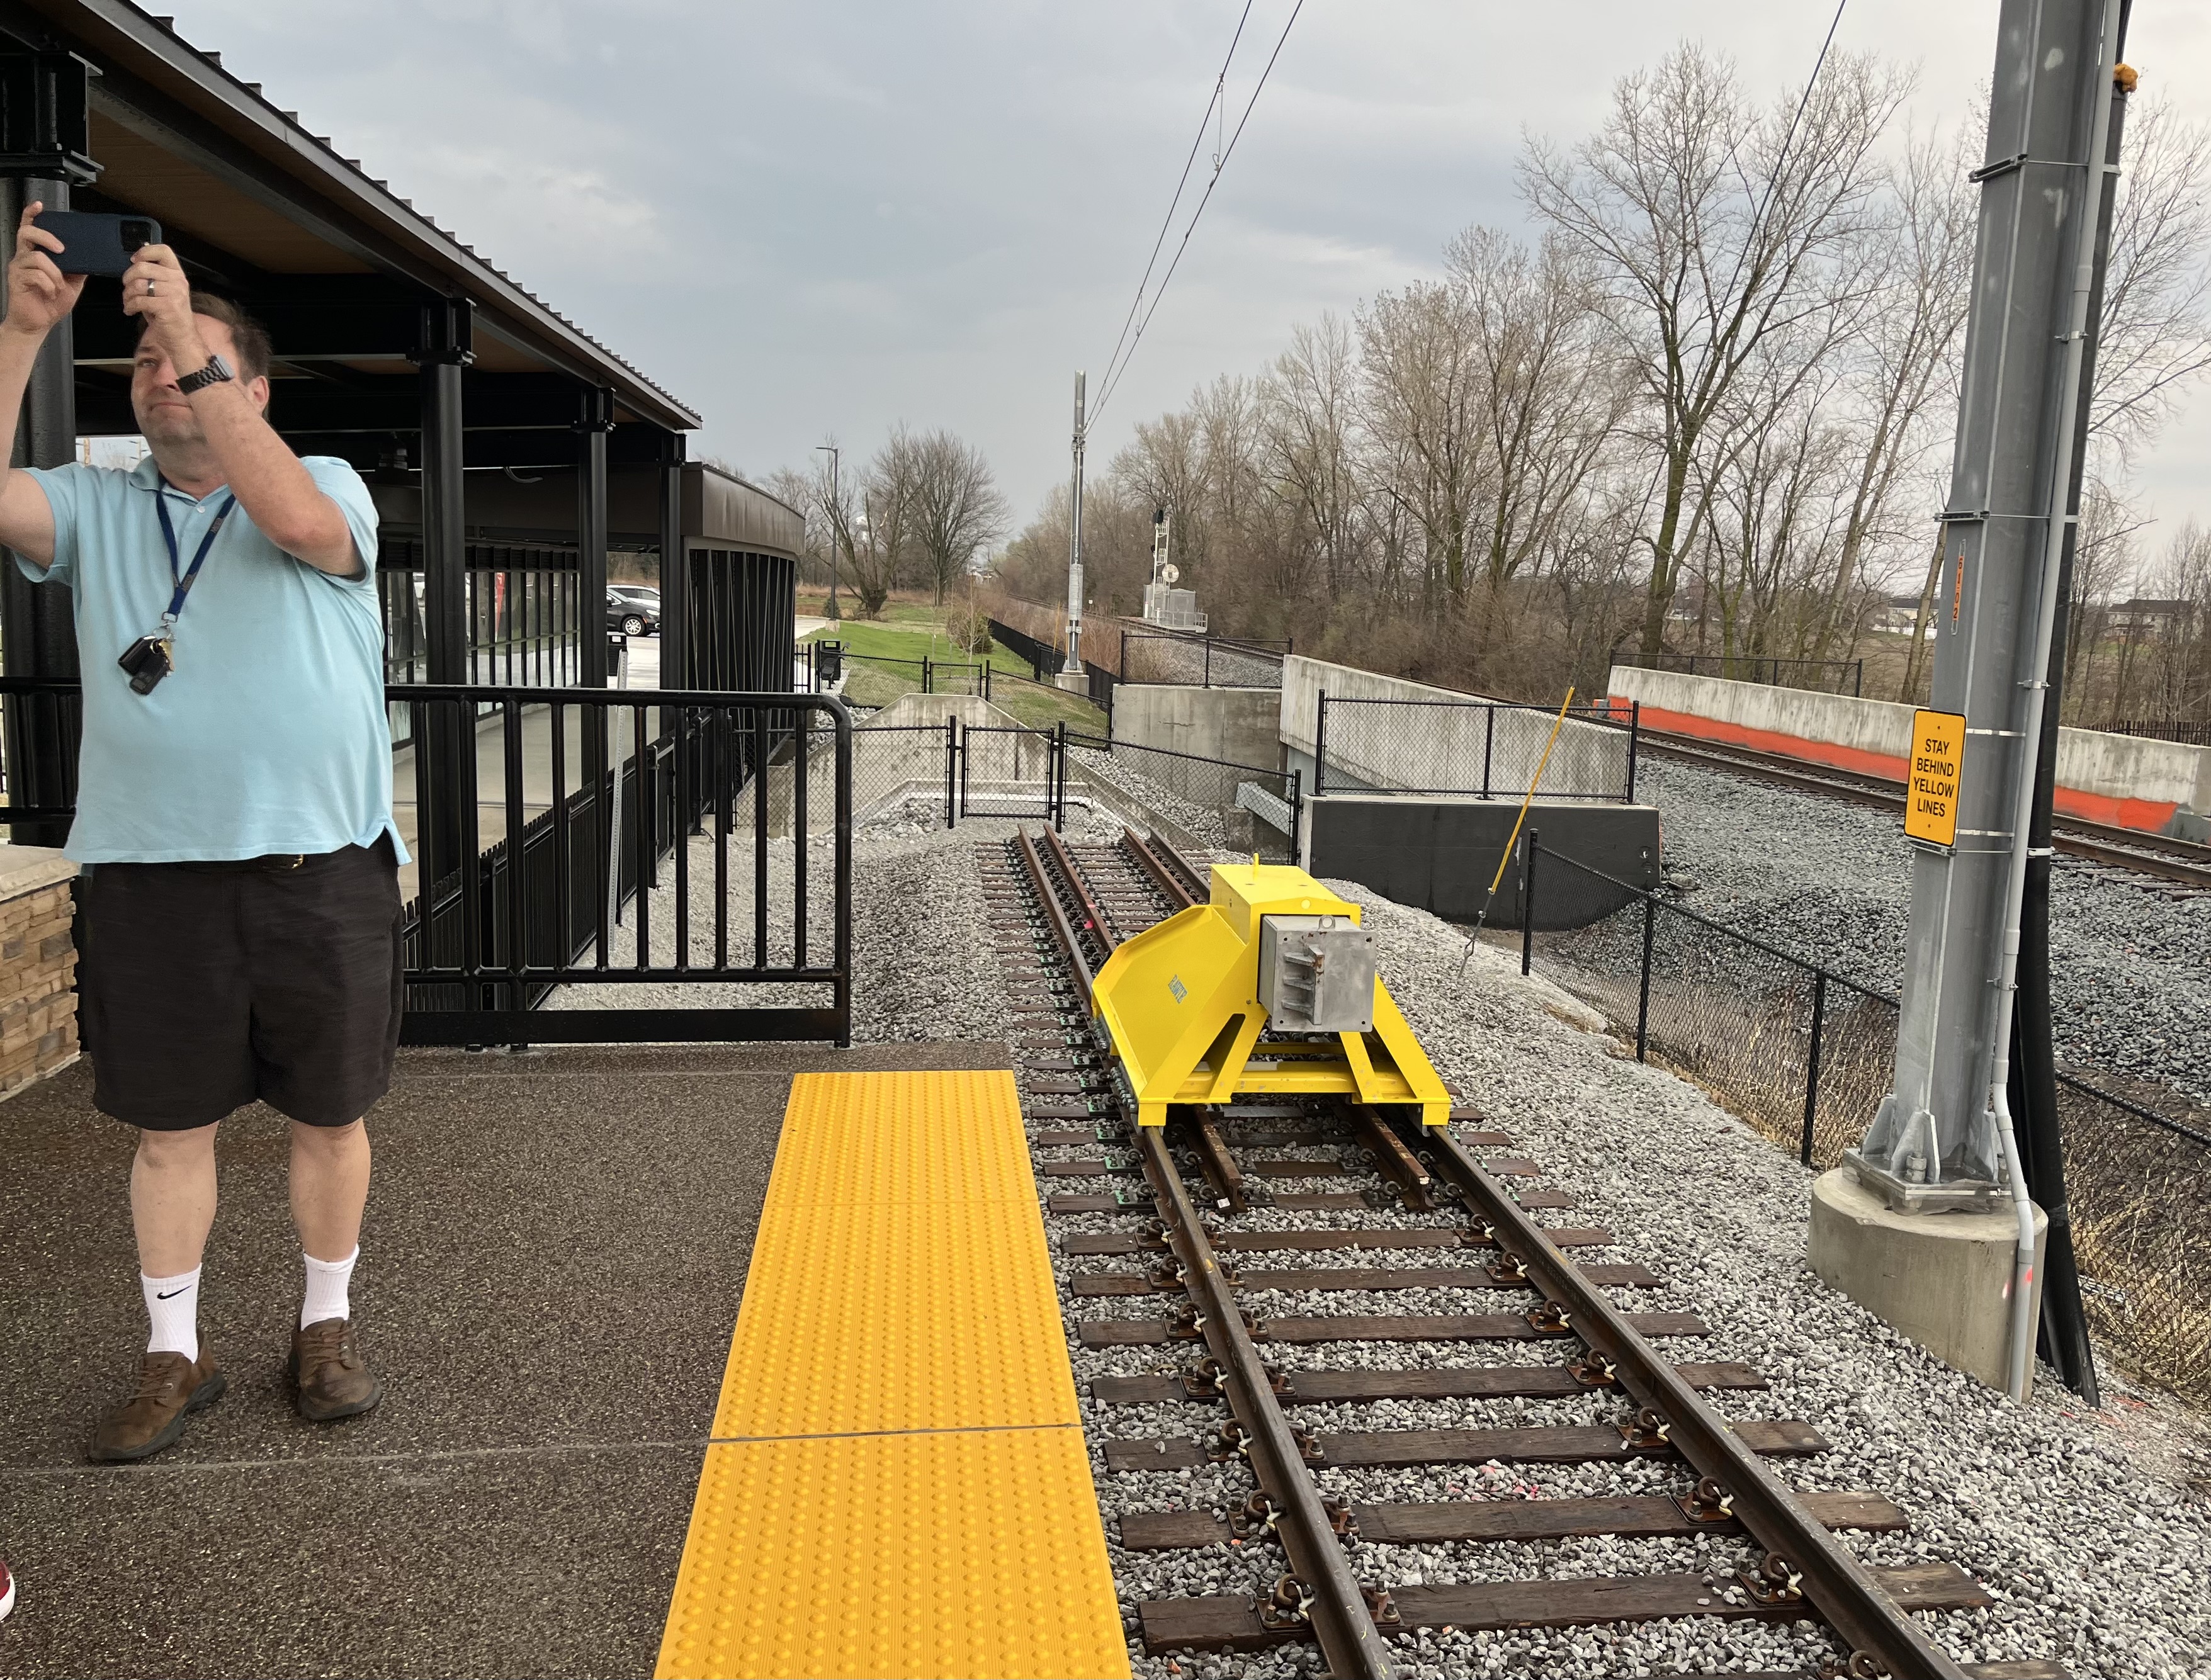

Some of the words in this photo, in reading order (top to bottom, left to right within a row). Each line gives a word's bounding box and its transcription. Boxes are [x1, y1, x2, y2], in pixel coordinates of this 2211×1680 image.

[1925, 738, 1950, 755] STAY
[1917, 757, 1954, 777] BEHIND
[1914, 777, 1955, 798] YELLOW
[1917, 798, 1945, 817] LINES
